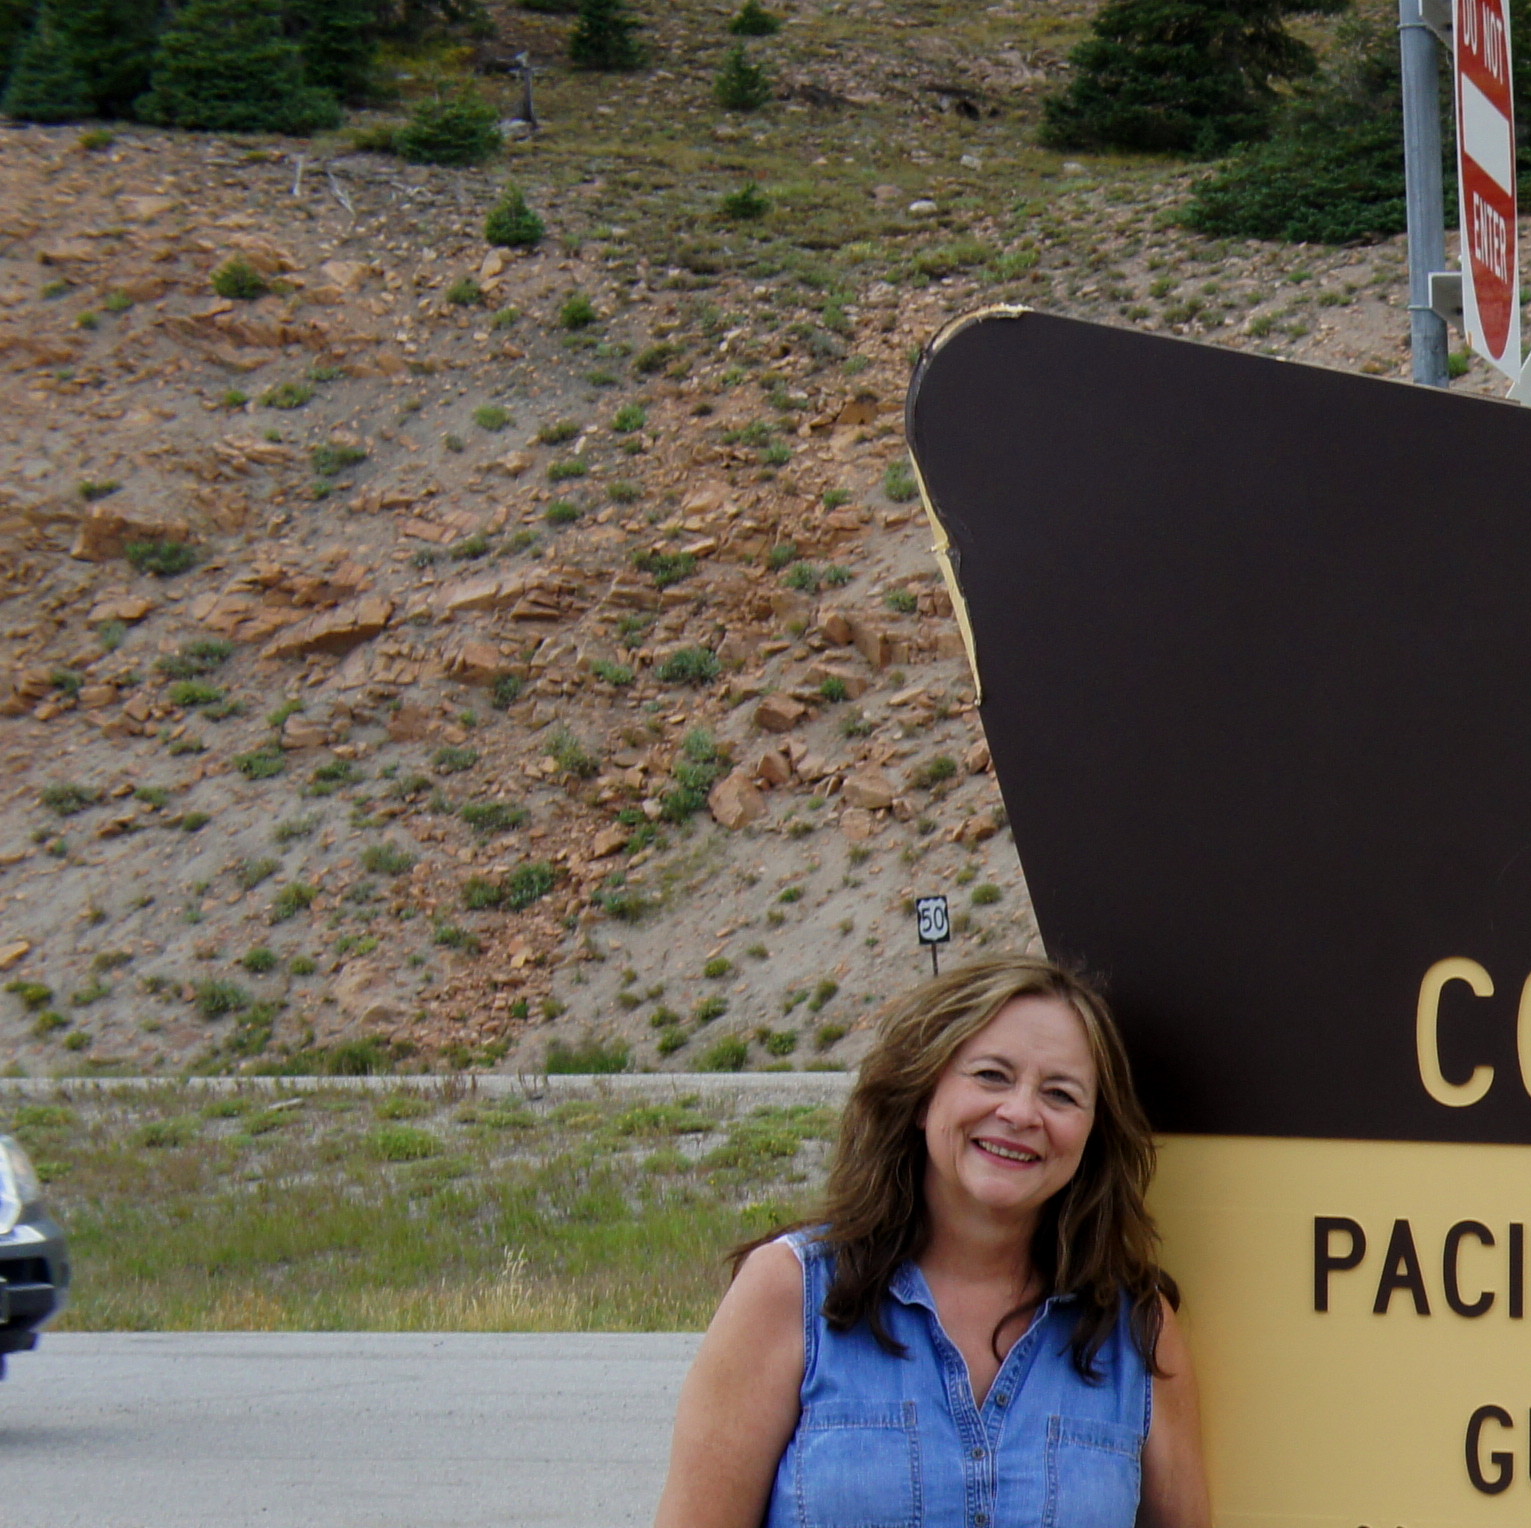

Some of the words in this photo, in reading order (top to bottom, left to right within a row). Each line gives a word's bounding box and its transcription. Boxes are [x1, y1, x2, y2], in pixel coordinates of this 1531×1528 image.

[1462, 0, 1478, 56] DO
[1482, 1, 1503, 86] NOT
[1472, 190, 1508, 285] ENTER
[921, 905, 945, 933] 50
